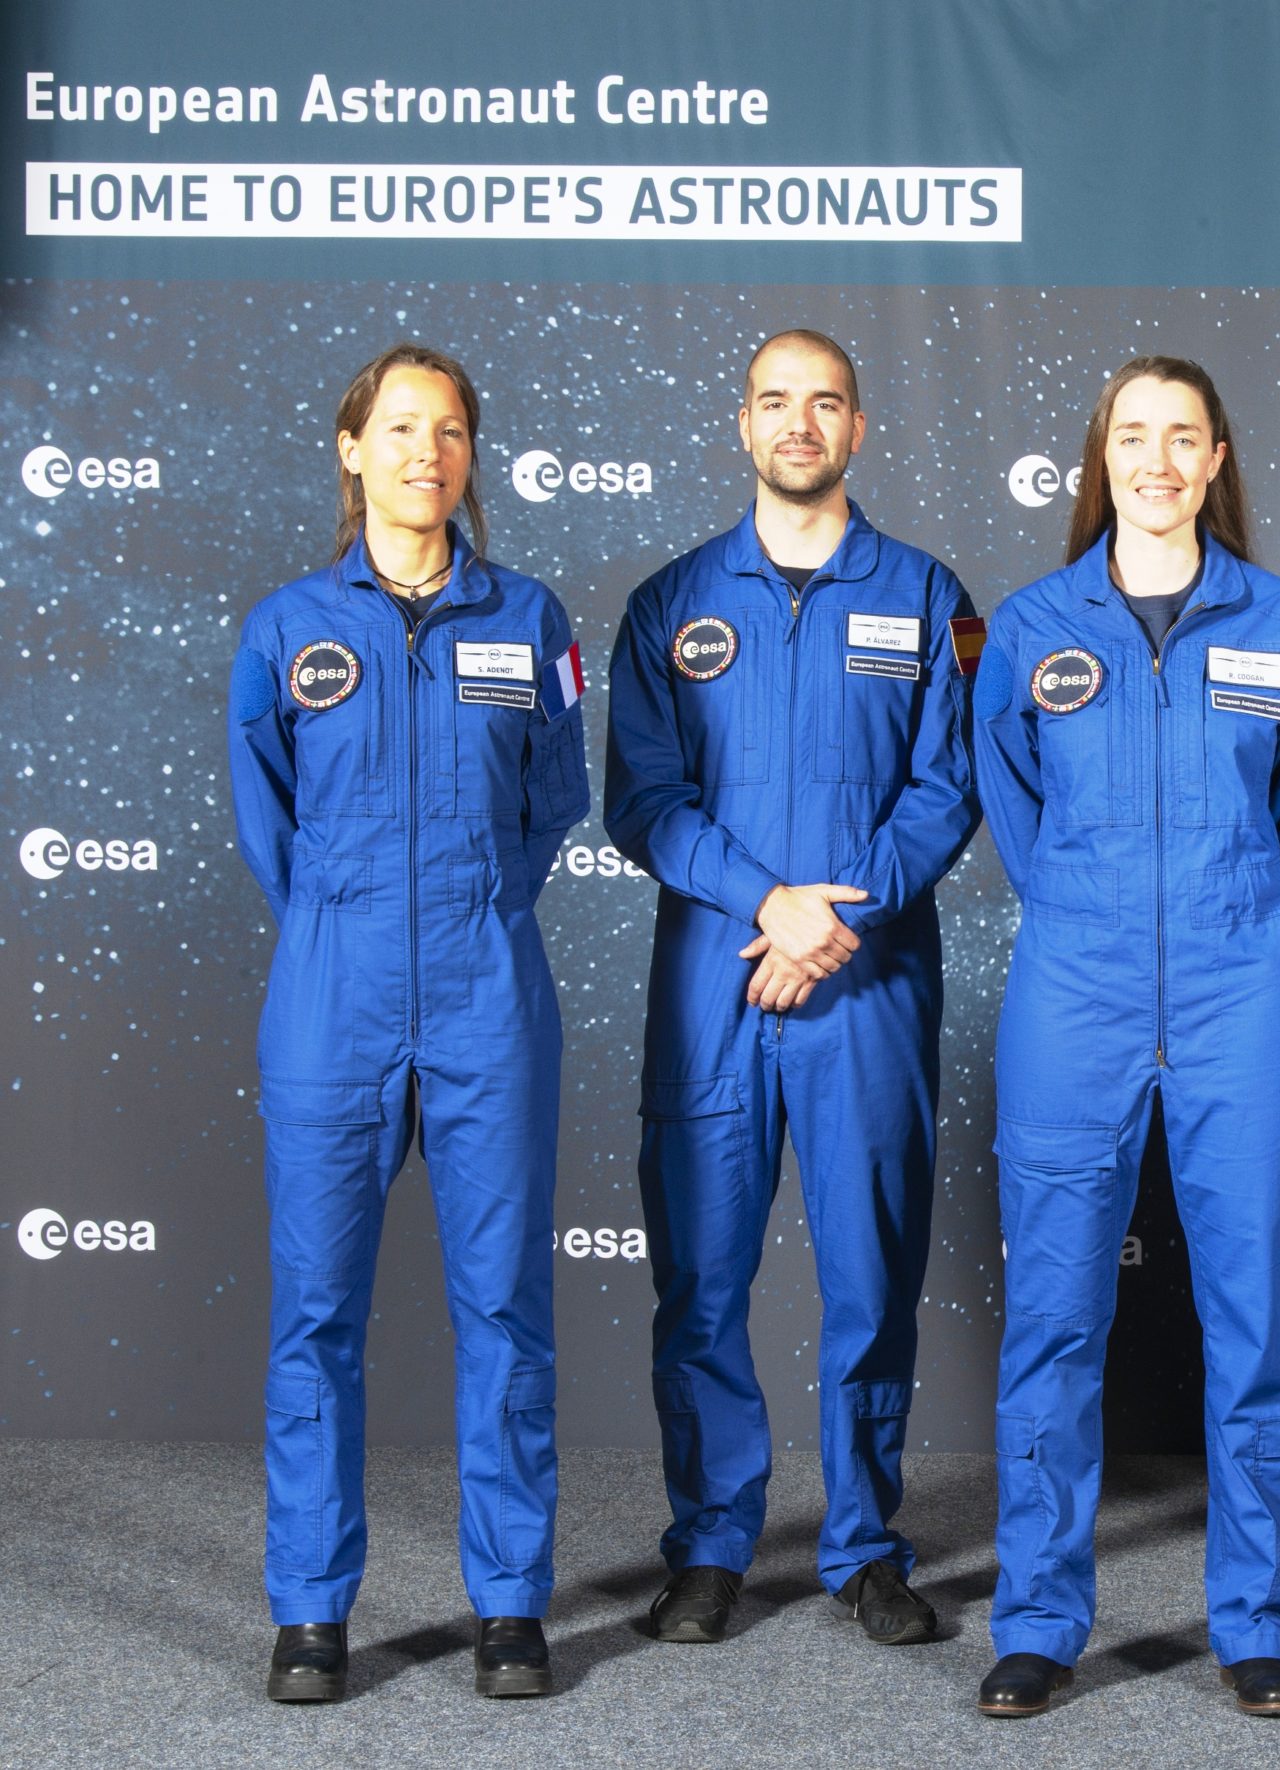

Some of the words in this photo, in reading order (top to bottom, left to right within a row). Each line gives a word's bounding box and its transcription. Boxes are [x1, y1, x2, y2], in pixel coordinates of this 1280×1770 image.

[27, 73, 278, 134] European
[301, 74, 576, 124] Astronaut
[598, 75, 769, 125] Centre
[49, 173, 208, 222] HOME
[233, 174, 302, 223] TO
[330, 175, 603, 225] EUROPE'S
[628, 176, 998, 227] ASTRONAUTS
[77, 457, 161, 489] esa
[568, 461, 653, 493] esa
[700, 641, 727, 654] esa
[317, 668, 347, 680] esa
[486, 666, 514, 674] ADENOT
[1060, 674, 1090, 686] esa
[75, 839, 158, 871] esa
[73, 1219, 156, 1252] esa
[563, 1227, 647, 1259] esa
